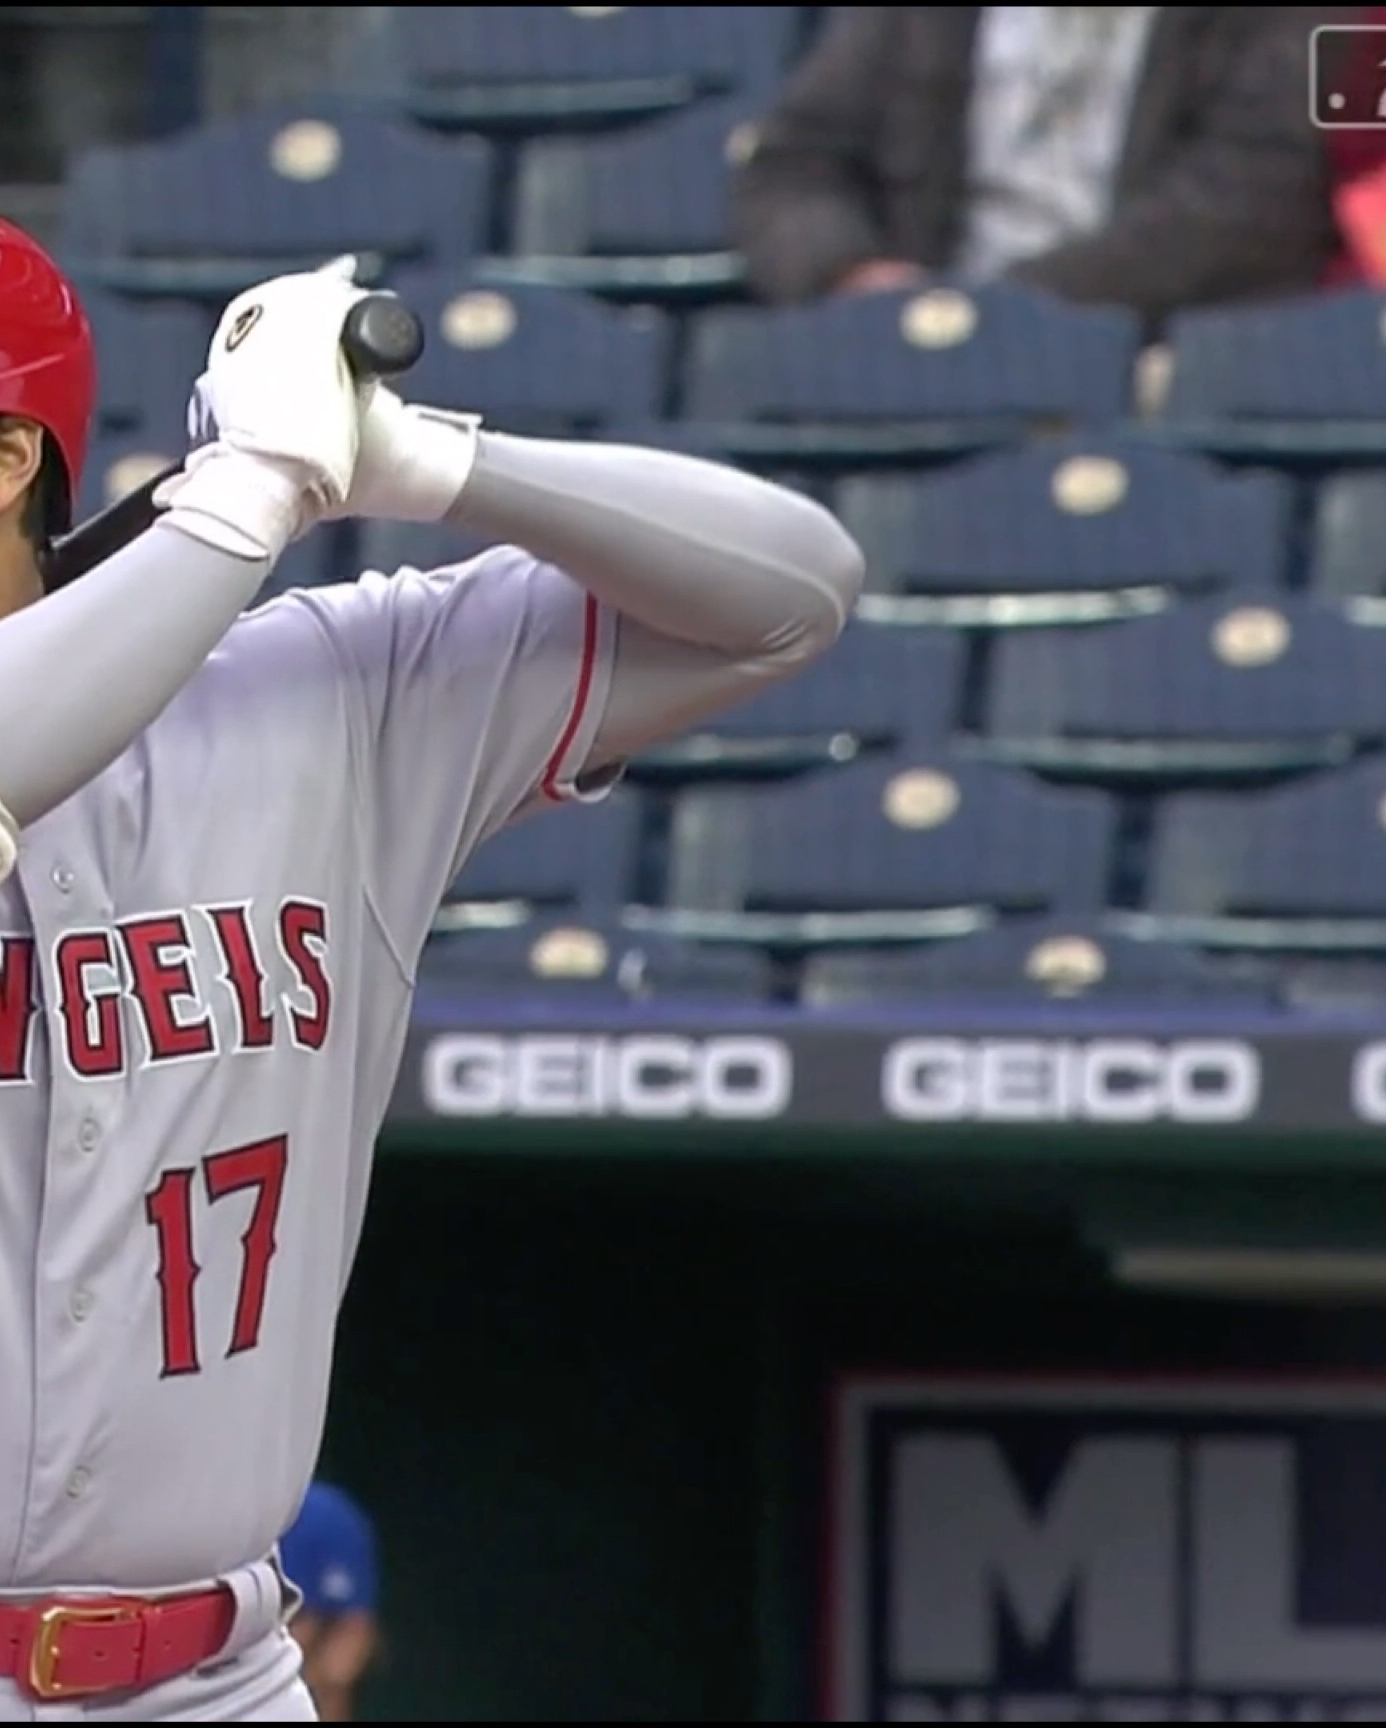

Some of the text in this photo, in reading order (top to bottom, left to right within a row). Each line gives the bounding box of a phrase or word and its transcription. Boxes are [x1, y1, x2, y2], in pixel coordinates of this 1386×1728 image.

[424, 1035, 793, 1117] GEICO
[882, 1037, 1260, 1122] GEICO
[145, 1133, 288, 1380] 17
